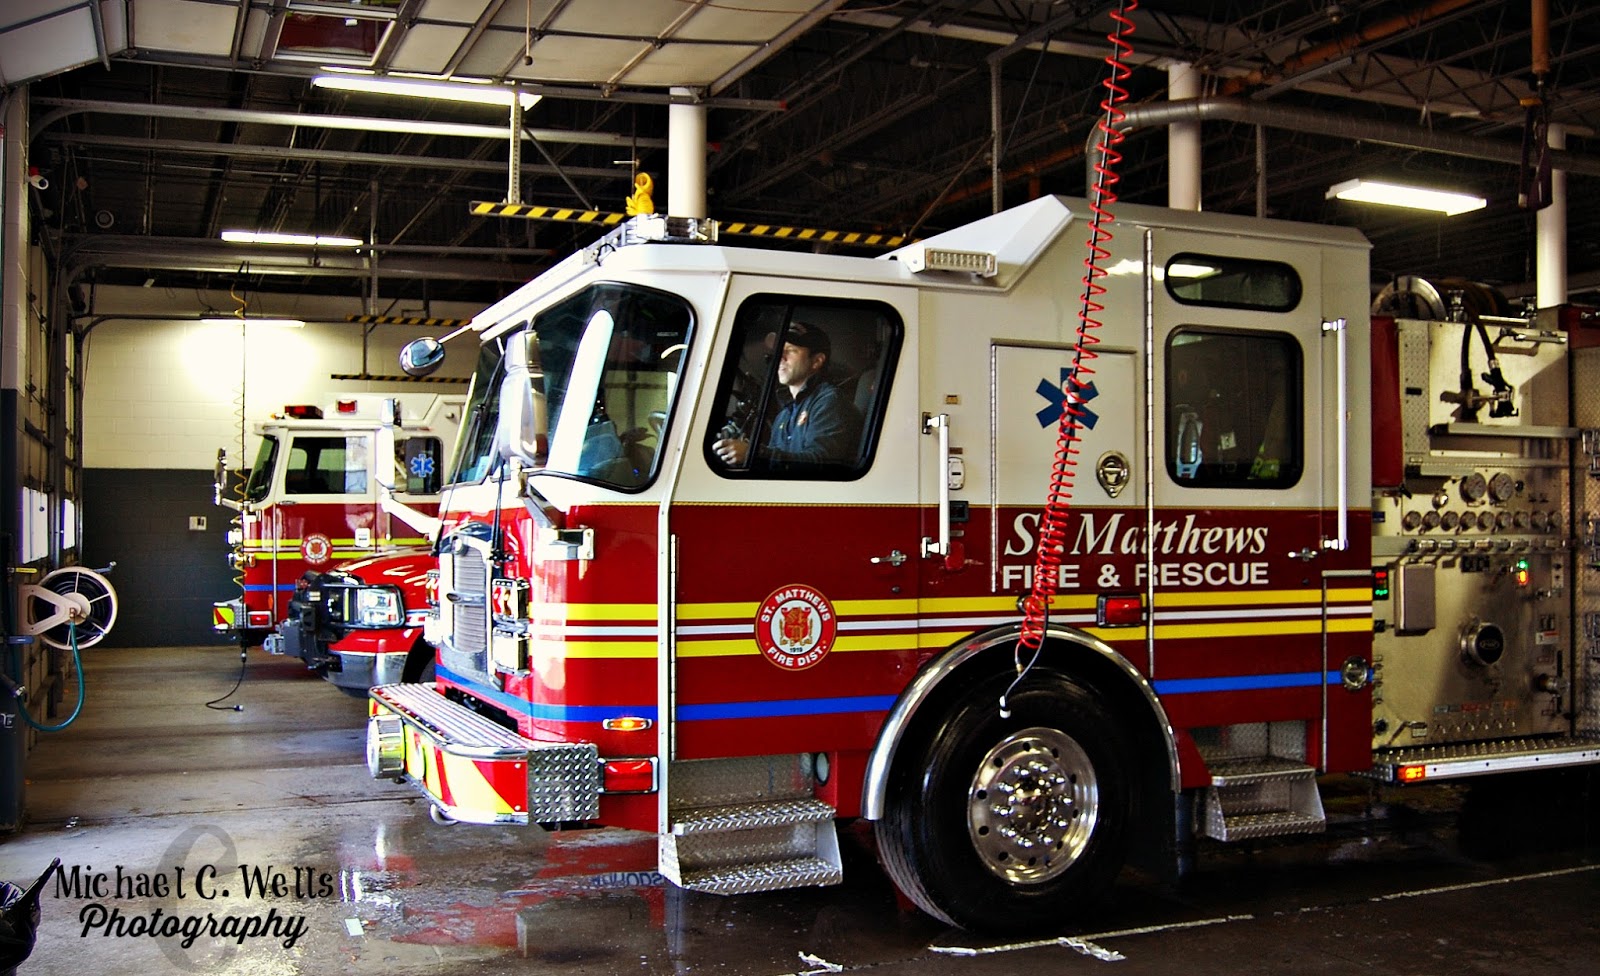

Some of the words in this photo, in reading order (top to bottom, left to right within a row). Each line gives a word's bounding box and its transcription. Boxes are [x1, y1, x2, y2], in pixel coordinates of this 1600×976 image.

[1070, 513, 1268, 555] Matthews
[1097, 564, 1121, 588] &
[1135, 562, 1269, 586] RESCUE
[761, 605, 776, 622] ST.
[775, 589, 831, 621] MATTHEWS
[767, 646, 794, 666] FIRE
[797, 645, 827, 666] DIST.
